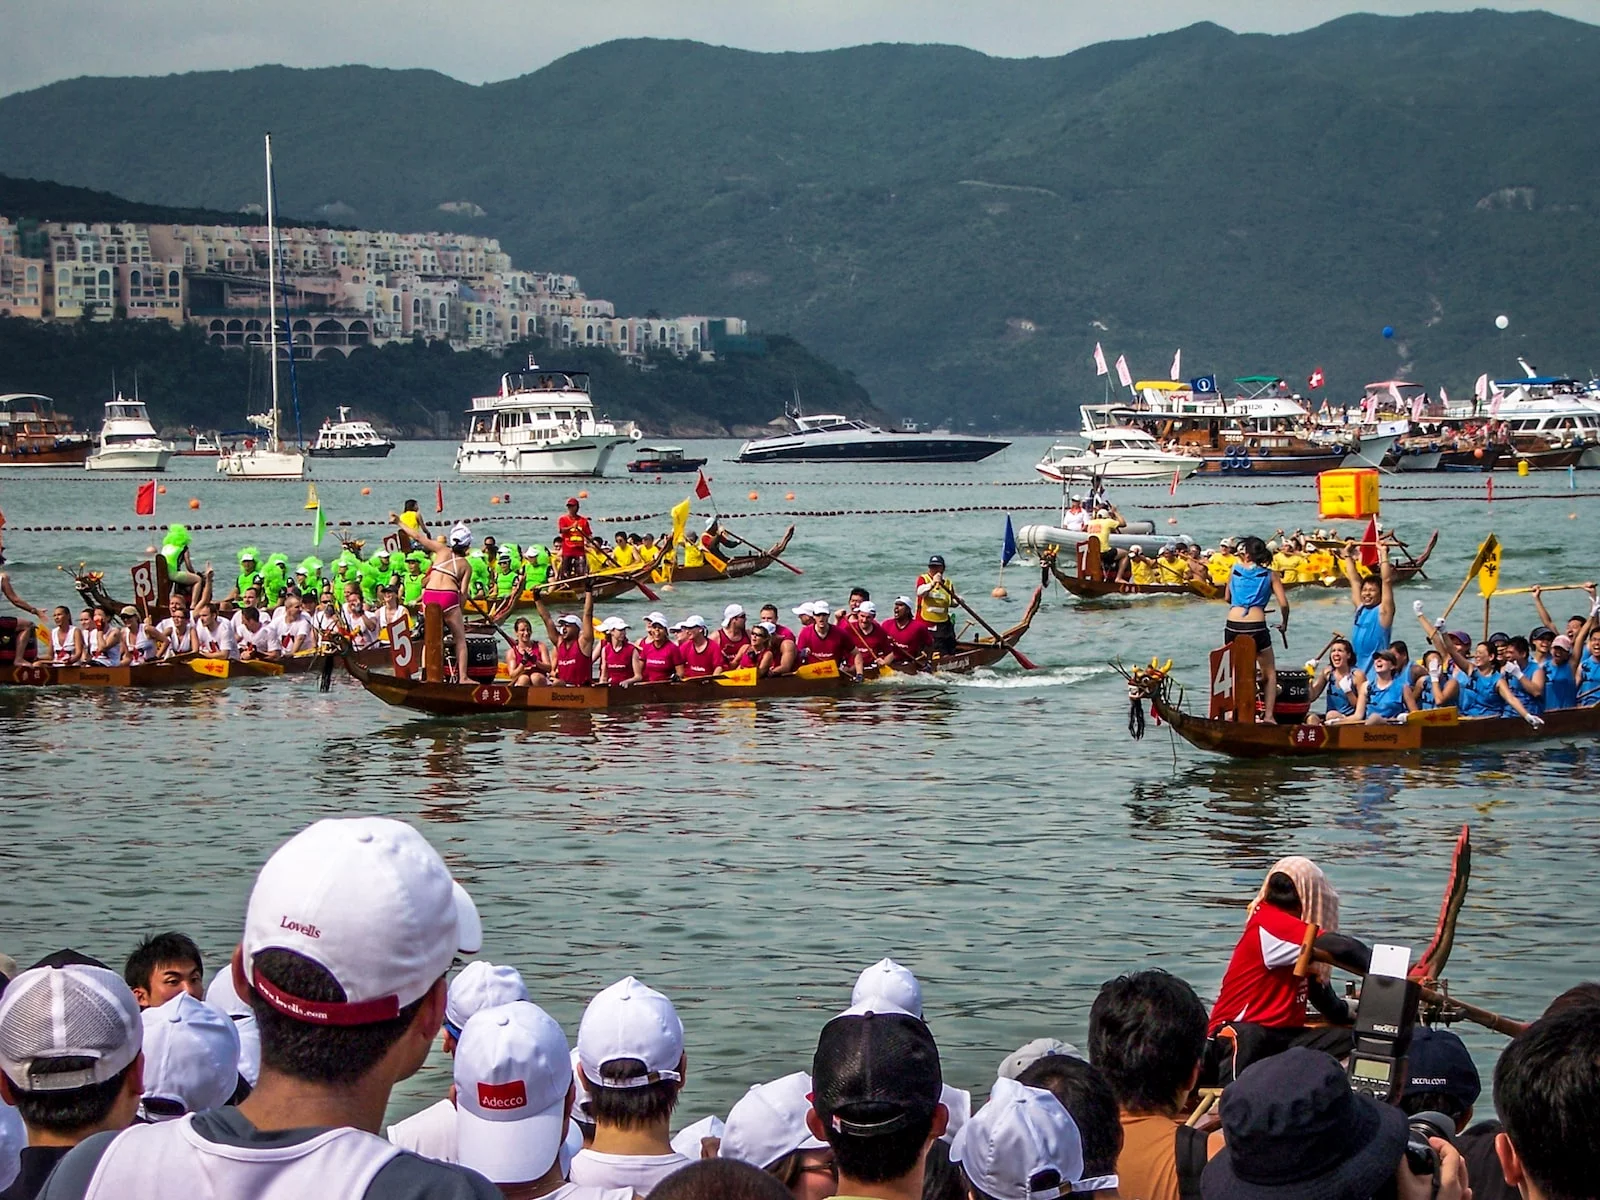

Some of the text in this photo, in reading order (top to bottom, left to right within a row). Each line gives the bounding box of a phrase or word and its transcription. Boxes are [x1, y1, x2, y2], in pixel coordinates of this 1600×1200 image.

[1078, 543, 1089, 571] 7
[134, 567, 151, 598] 8
[391, 620, 412, 667] 5
[1213, 649, 1232, 699] 4
[551, 692, 585, 703] Bloomberg
[1363, 732, 1398, 745] Bloomberg
[280, 915, 321, 939] Lovells
[258, 982, 328, 1019] www.lovells.com
[482, 1096, 524, 1107] Adecco
